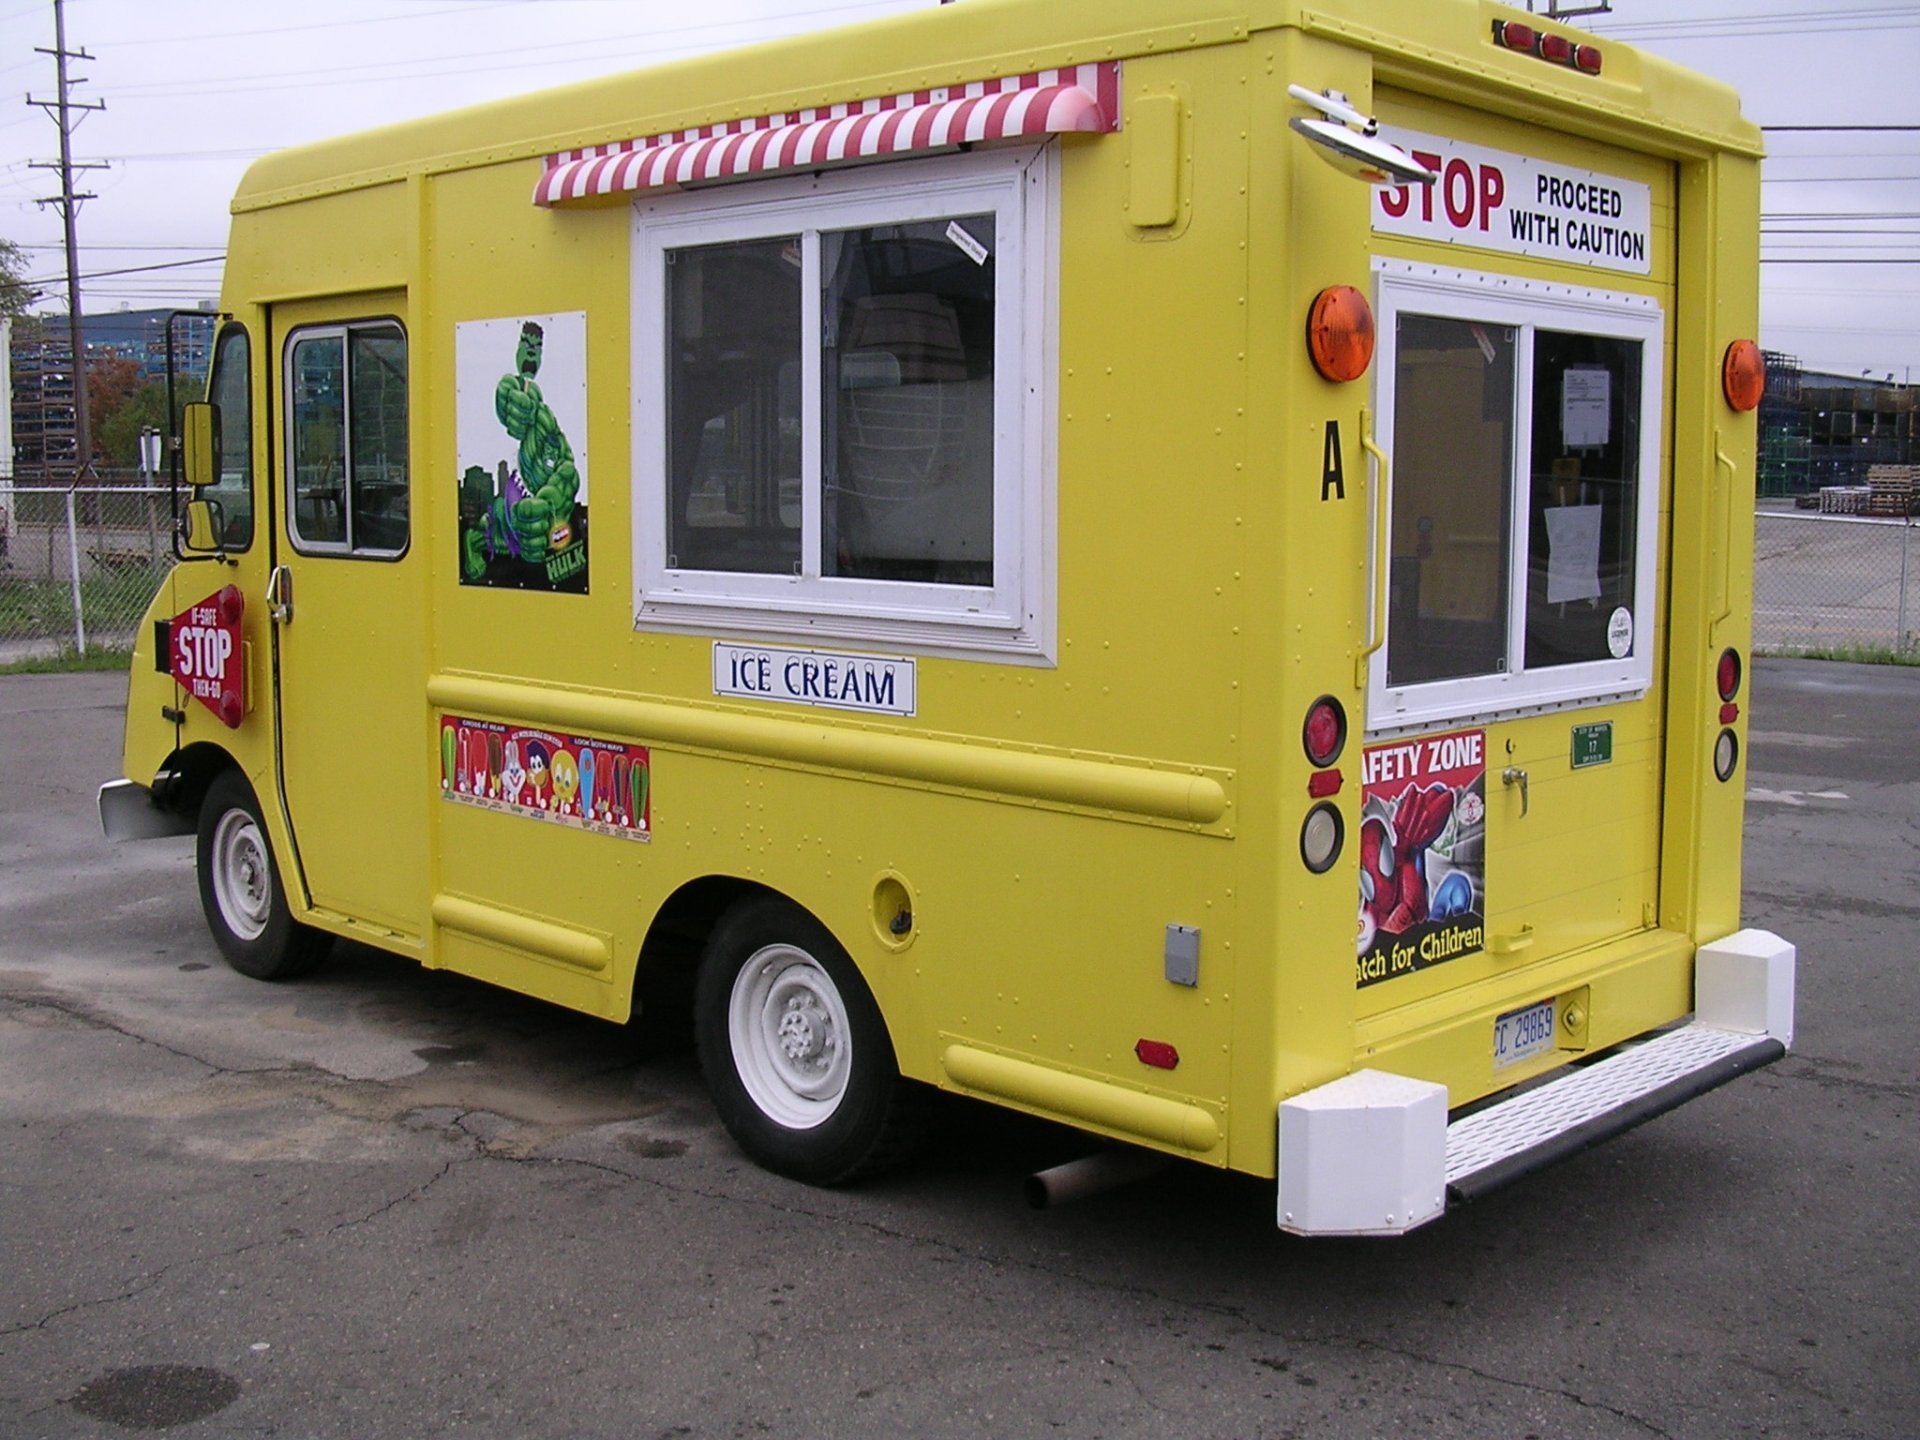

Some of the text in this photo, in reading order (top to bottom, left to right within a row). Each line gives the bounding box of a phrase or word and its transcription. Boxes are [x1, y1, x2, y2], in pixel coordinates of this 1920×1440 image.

[1379, 144, 1504, 232] STOP
[1537, 174, 1622, 218] PROCEED
[1510, 208, 1645, 261] WITH CAUTION
[1321, 420, 1345, 501] A
[545, 545, 587, 583] HULK
[191, 607, 217, 626] IF-SAFE
[179, 626, 232, 679] STOP
[731, 650, 895, 705] ICE CREAM
[193, 678, 221, 698] THEN-GO
[1362, 734, 1482, 785] FETY ZONE
[1356, 926, 1482, 980] atch for Children
[1515, 1007, 1553, 1048] 29869
